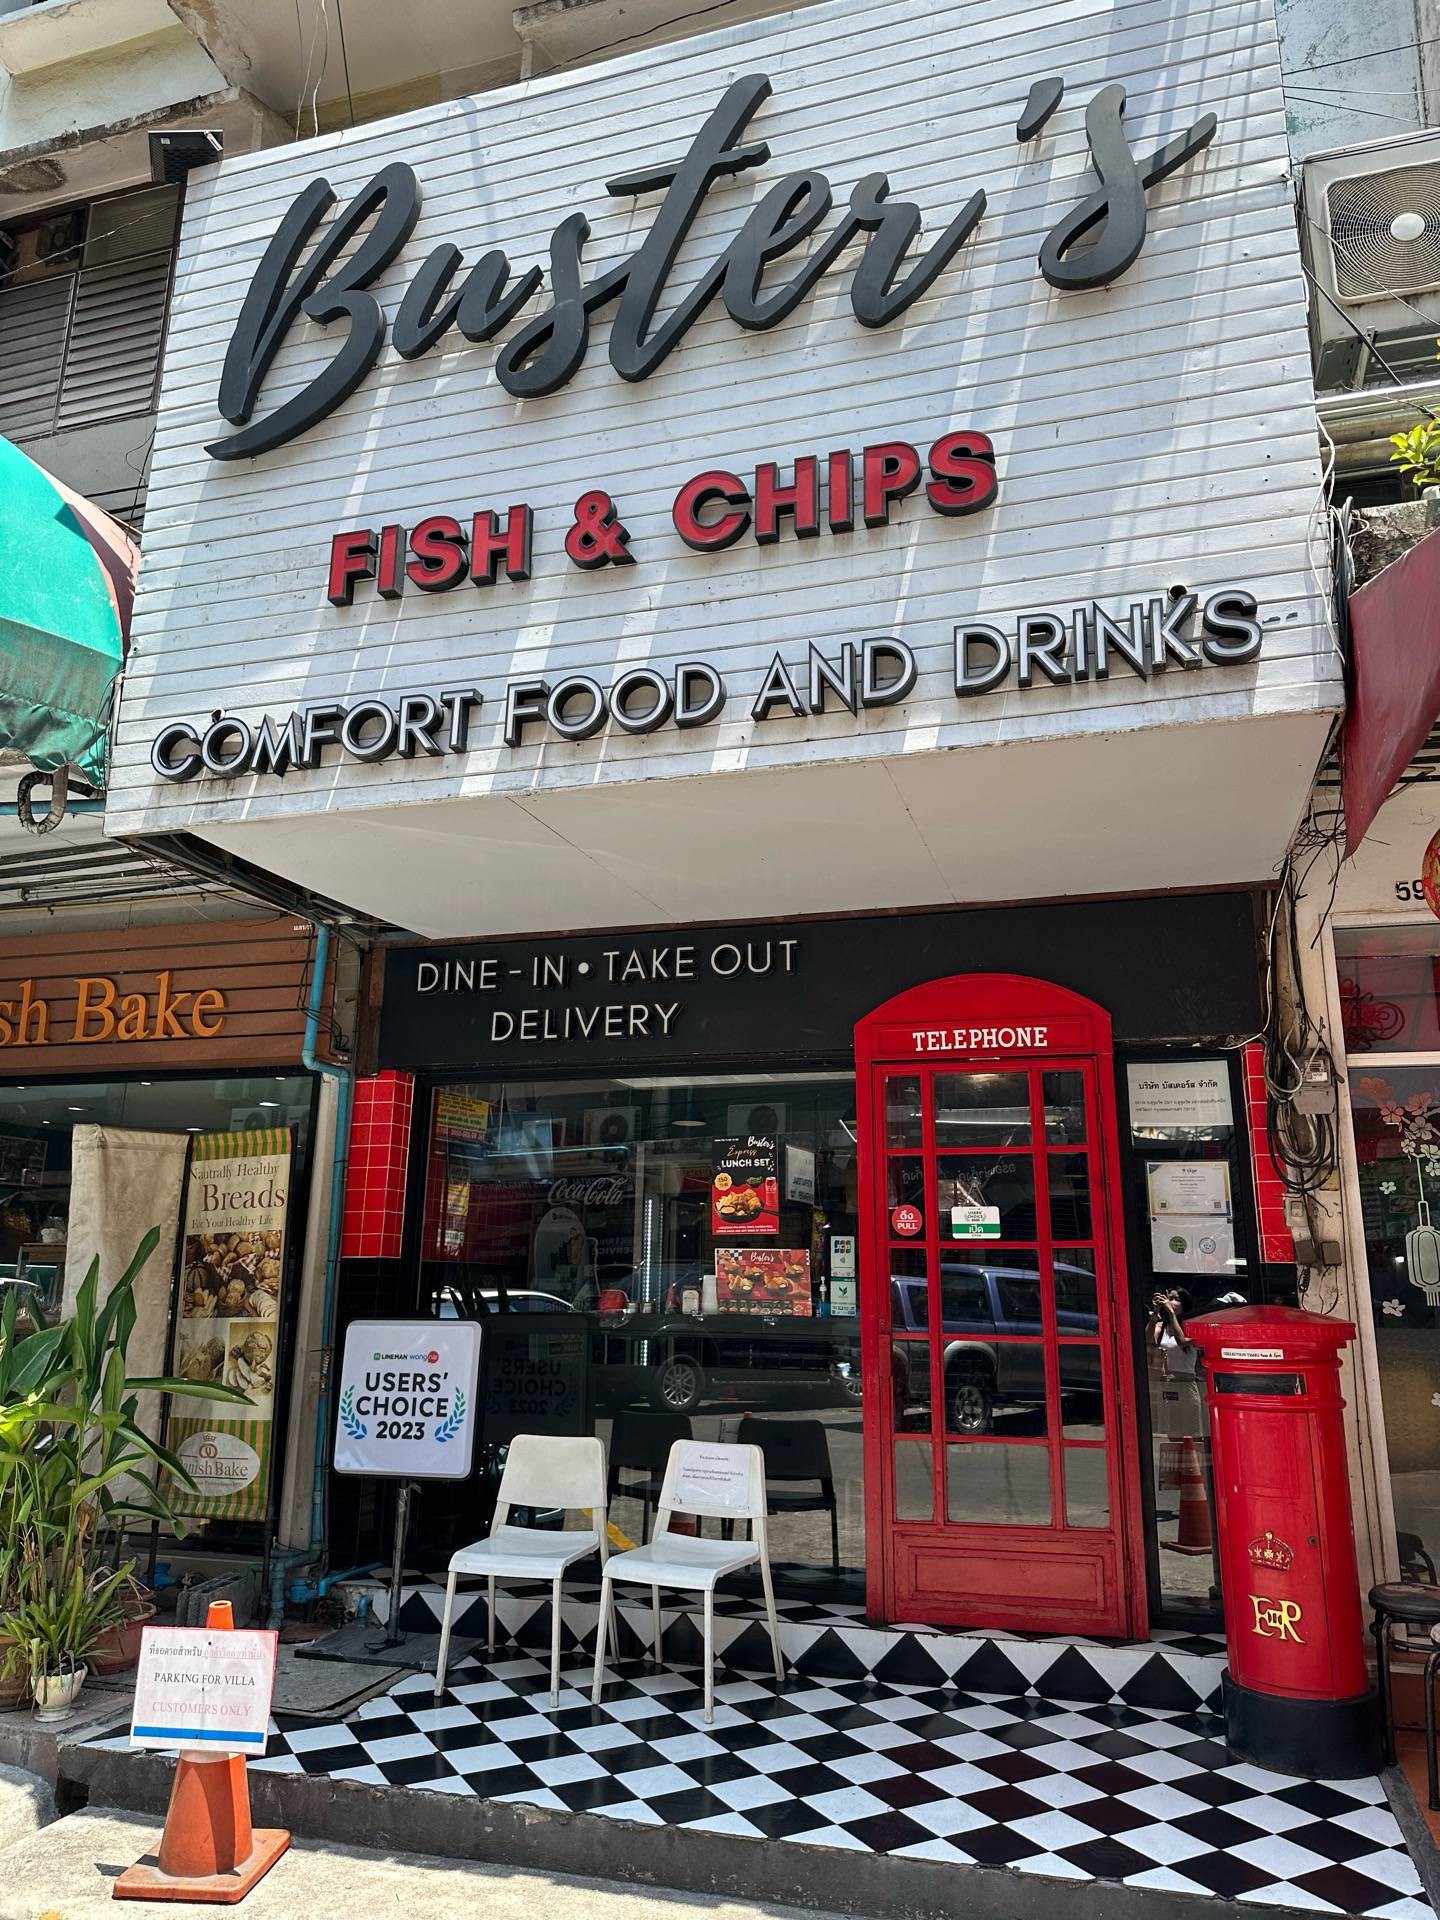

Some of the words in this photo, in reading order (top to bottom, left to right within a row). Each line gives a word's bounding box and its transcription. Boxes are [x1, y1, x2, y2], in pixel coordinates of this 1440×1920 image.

[204, 72, 1218, 462] Buster's
[328, 503, 534, 606] FISH
[564, 490, 637, 569] &
[672, 430, 998, 552] CHIPS
[151, 689, 483, 782] COMFORT
[504, 661, 727, 748] FOOD
[751, 636, 918, 721] AND
[953, 589, 1263, 697] DRINKS
[417, 959, 498, 992] DINE
[532, 955, 565, 987] IN
[602, 945, 695, 982] TAKE
[710, 940, 799, 976] OUT
[67, 970, 226, 1043] Bake
[490, 1002, 680, 1042] DELIVERY
[912, 1026, 1048, 1052] TELEPHONE
[237, 1162, 280, 1177] Healthy
[721, 1159, 752, 1168] LUNCH
[754, 1158, 771, 1167] SET
[202, 1180, 286, 1212] Breads
[899, 1209, 915, 1220] ดึง
[897, 1222, 918, 1231] PULL
[365, 1371, 449, 1393] USERS'
[356, 1396, 449, 1417] CHOICE
[376, 1421, 425, 1440] 2023
[181, 1459, 213, 1476] anish
[215, 1461, 248, 1477] Bake
[154, 1672, 199, 1684] PARKING
[202, 1674, 221, 1685] FOR
[224, 1675, 256, 1686] VILLA
[152, 1701, 218, 1716] CUSTOMERS
[220, 1705, 253, 1717] ONLY
